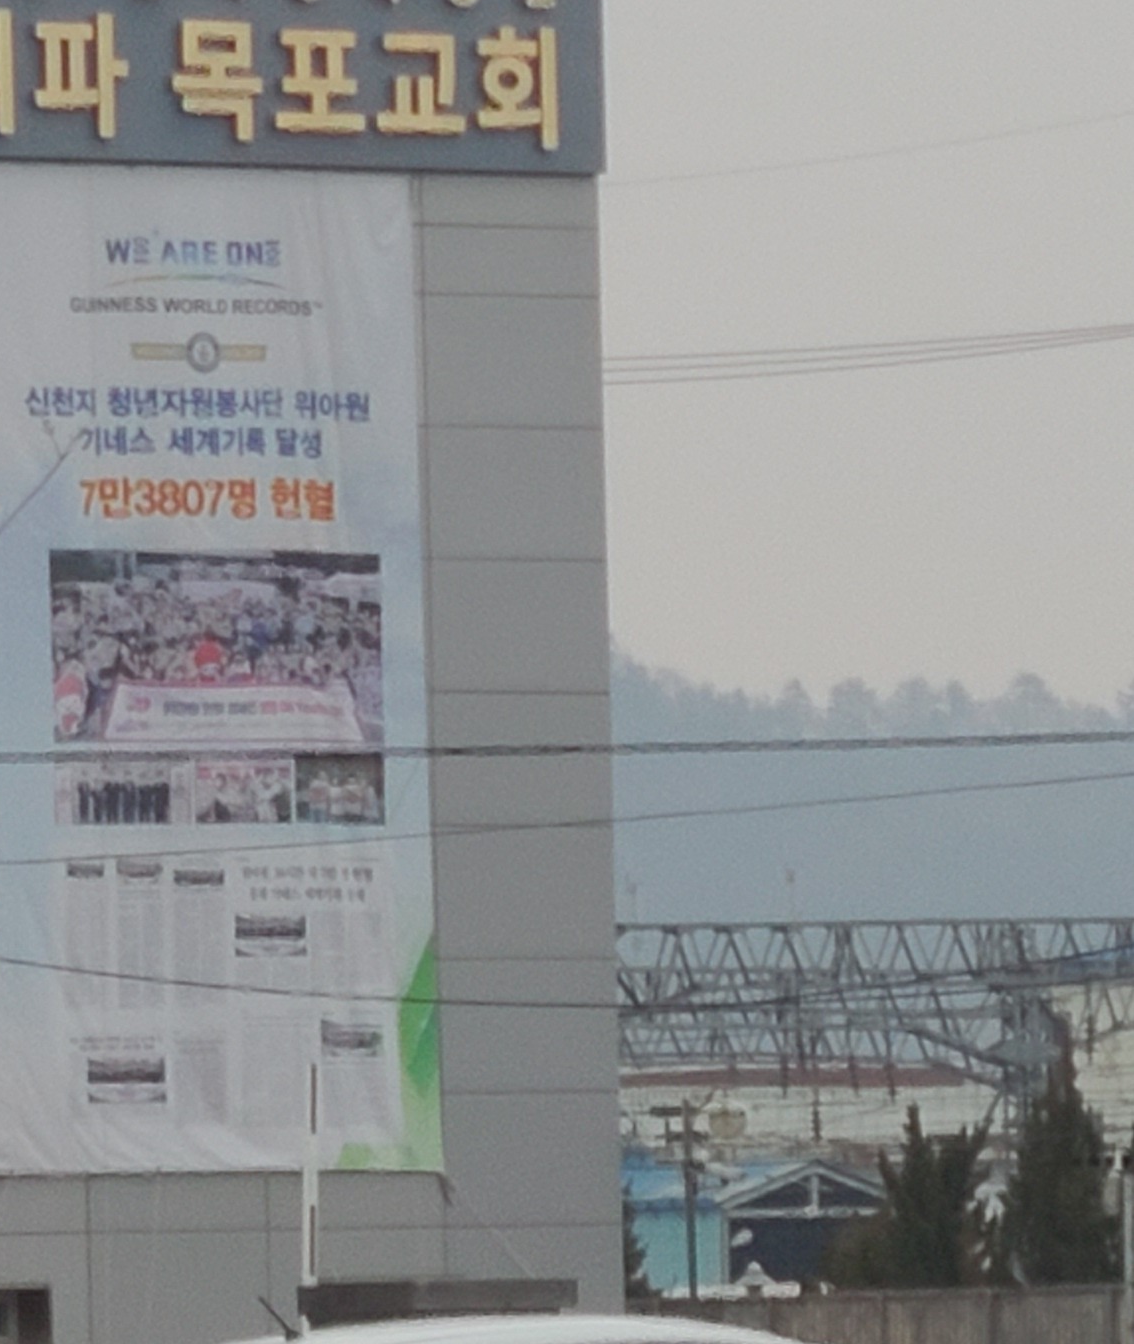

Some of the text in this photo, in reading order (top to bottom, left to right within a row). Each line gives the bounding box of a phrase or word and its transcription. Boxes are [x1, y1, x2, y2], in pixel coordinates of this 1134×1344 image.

[172, 18, 560, 152] 목포교회
[161, 240, 218, 266] ARE
[70, 296, 158, 314] GUINNESS
[163, 297, 228, 315] WORLD
[25, 386, 371, 423] 신천지 청년자원봉사단 위아원
[81, 426, 323, 458] 기네스 세계기록 달성
[79, 476, 337, 522] 7만3807명 헌혈
